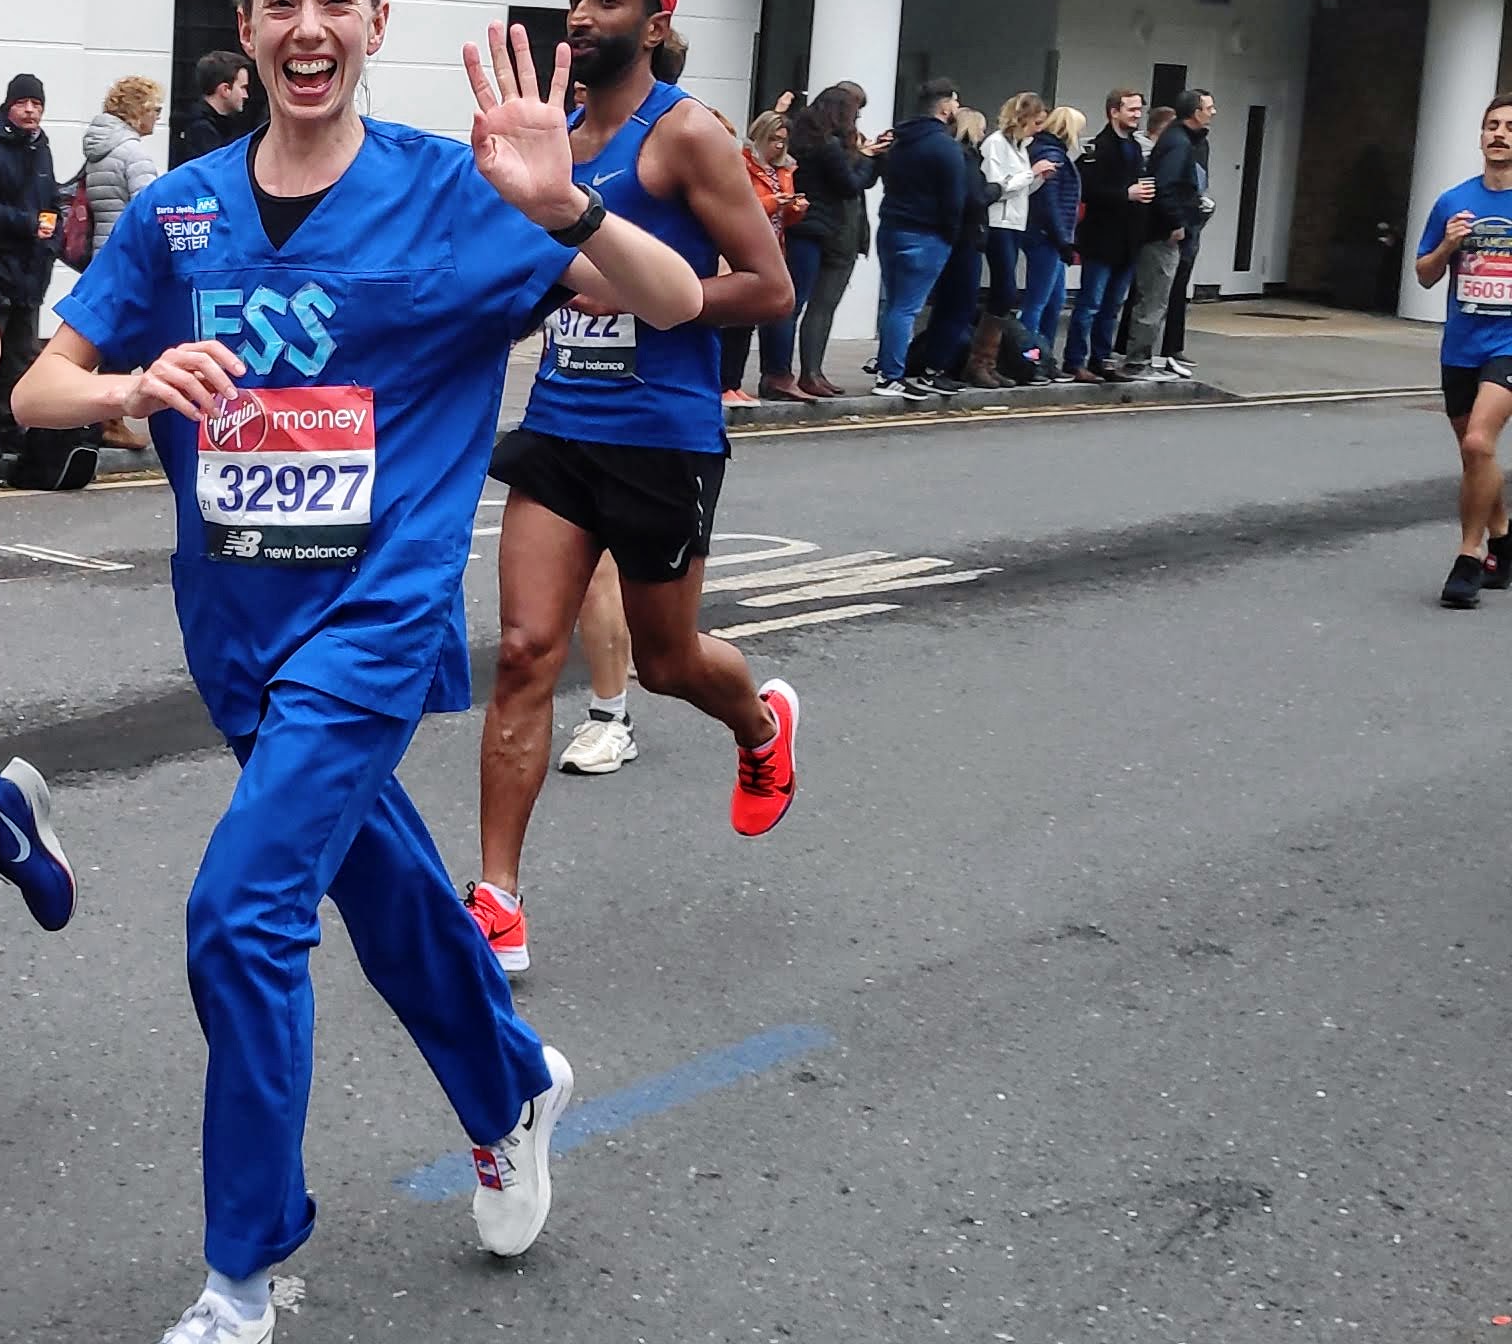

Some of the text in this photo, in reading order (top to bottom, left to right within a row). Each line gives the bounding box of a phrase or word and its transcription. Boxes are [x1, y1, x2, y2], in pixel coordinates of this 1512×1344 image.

[164, 221, 211, 237] SENIOR
[168, 236, 209, 252] SISTER
[585, 360, 625, 371] balance
[272, 408, 367, 435] money
[216, 464, 369, 513] 32927
[264, 547, 292, 560] new
[294, 545, 358, 560] balance
